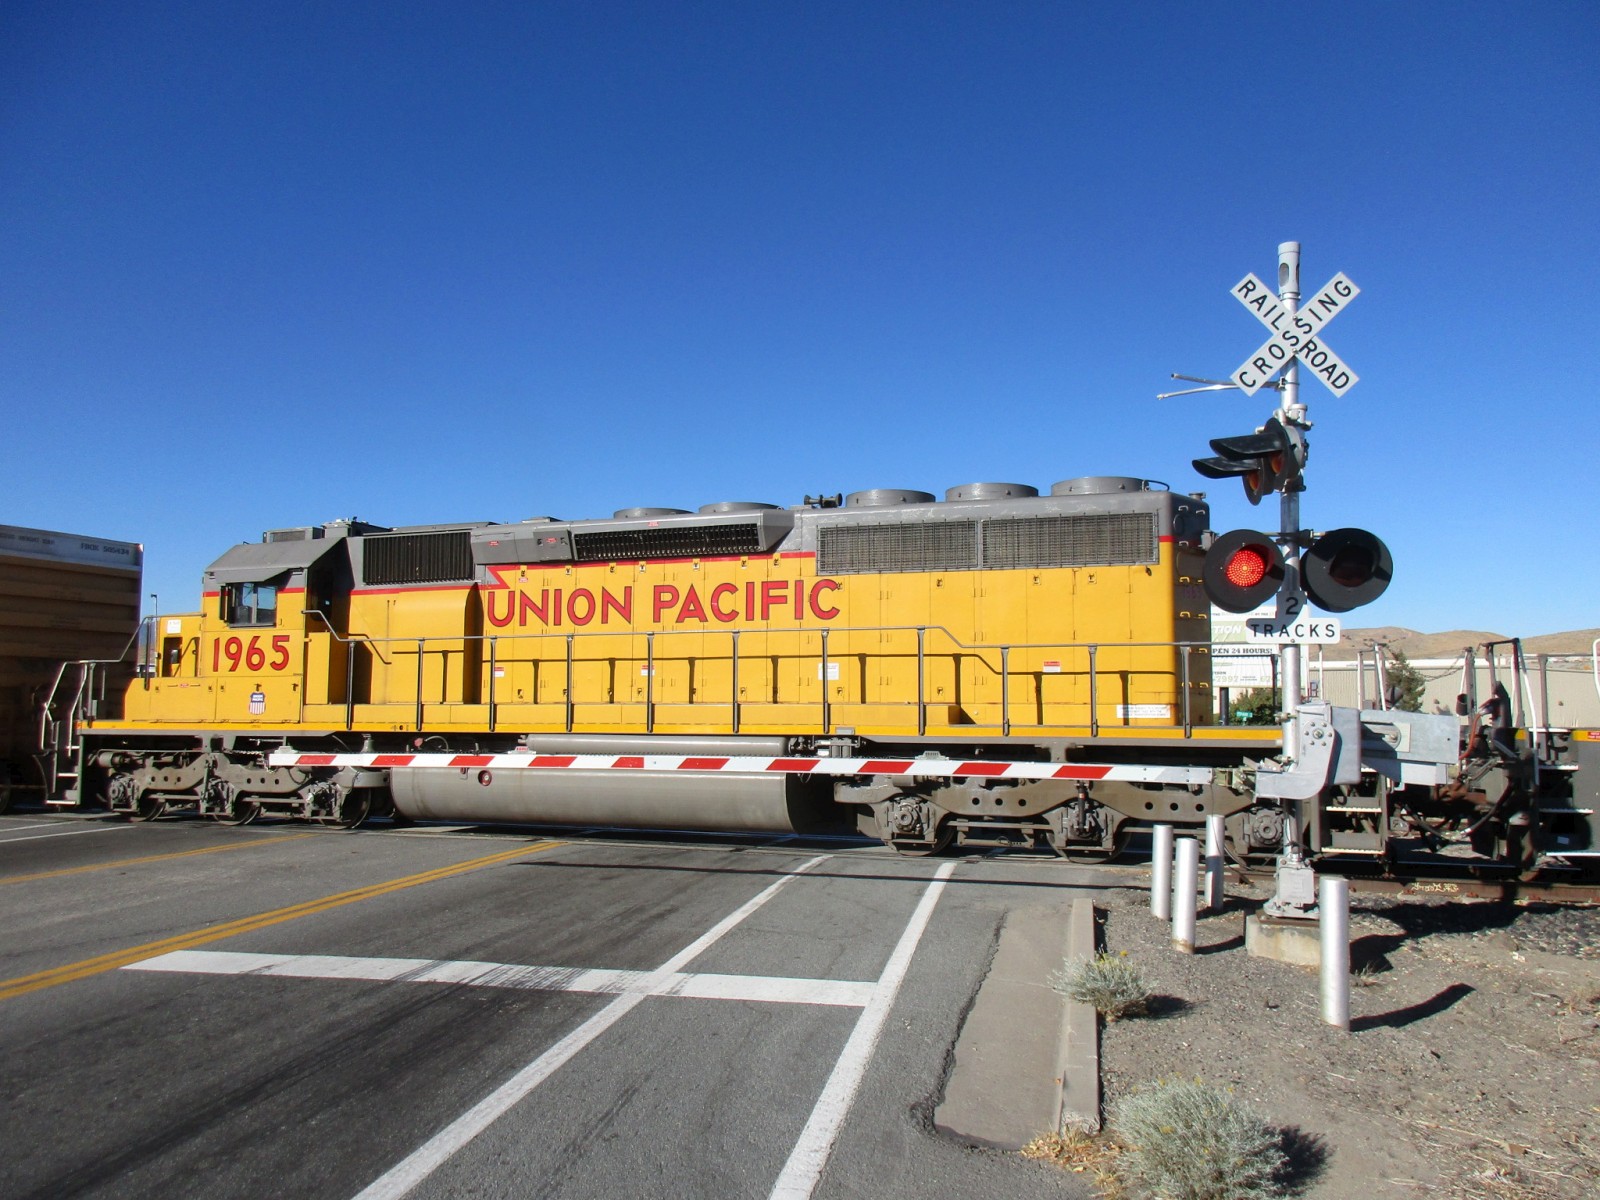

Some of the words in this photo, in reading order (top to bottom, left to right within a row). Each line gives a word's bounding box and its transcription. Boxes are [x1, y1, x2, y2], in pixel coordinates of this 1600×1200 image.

[1238, 280, 1352, 388] CROSSING
[1238, 280, 1286, 331] RAIL
[1299, 338, 1350, 390] ROAD
[487, 586, 632, 627] UNION
[652, 579, 841, 624] PACIFIC
[1285, 596, 1299, 615] 2
[1212, 625, 1242, 634] TION
[1251, 623, 1335, 638] TRACKS
[212, 634, 290, 672] 1965
